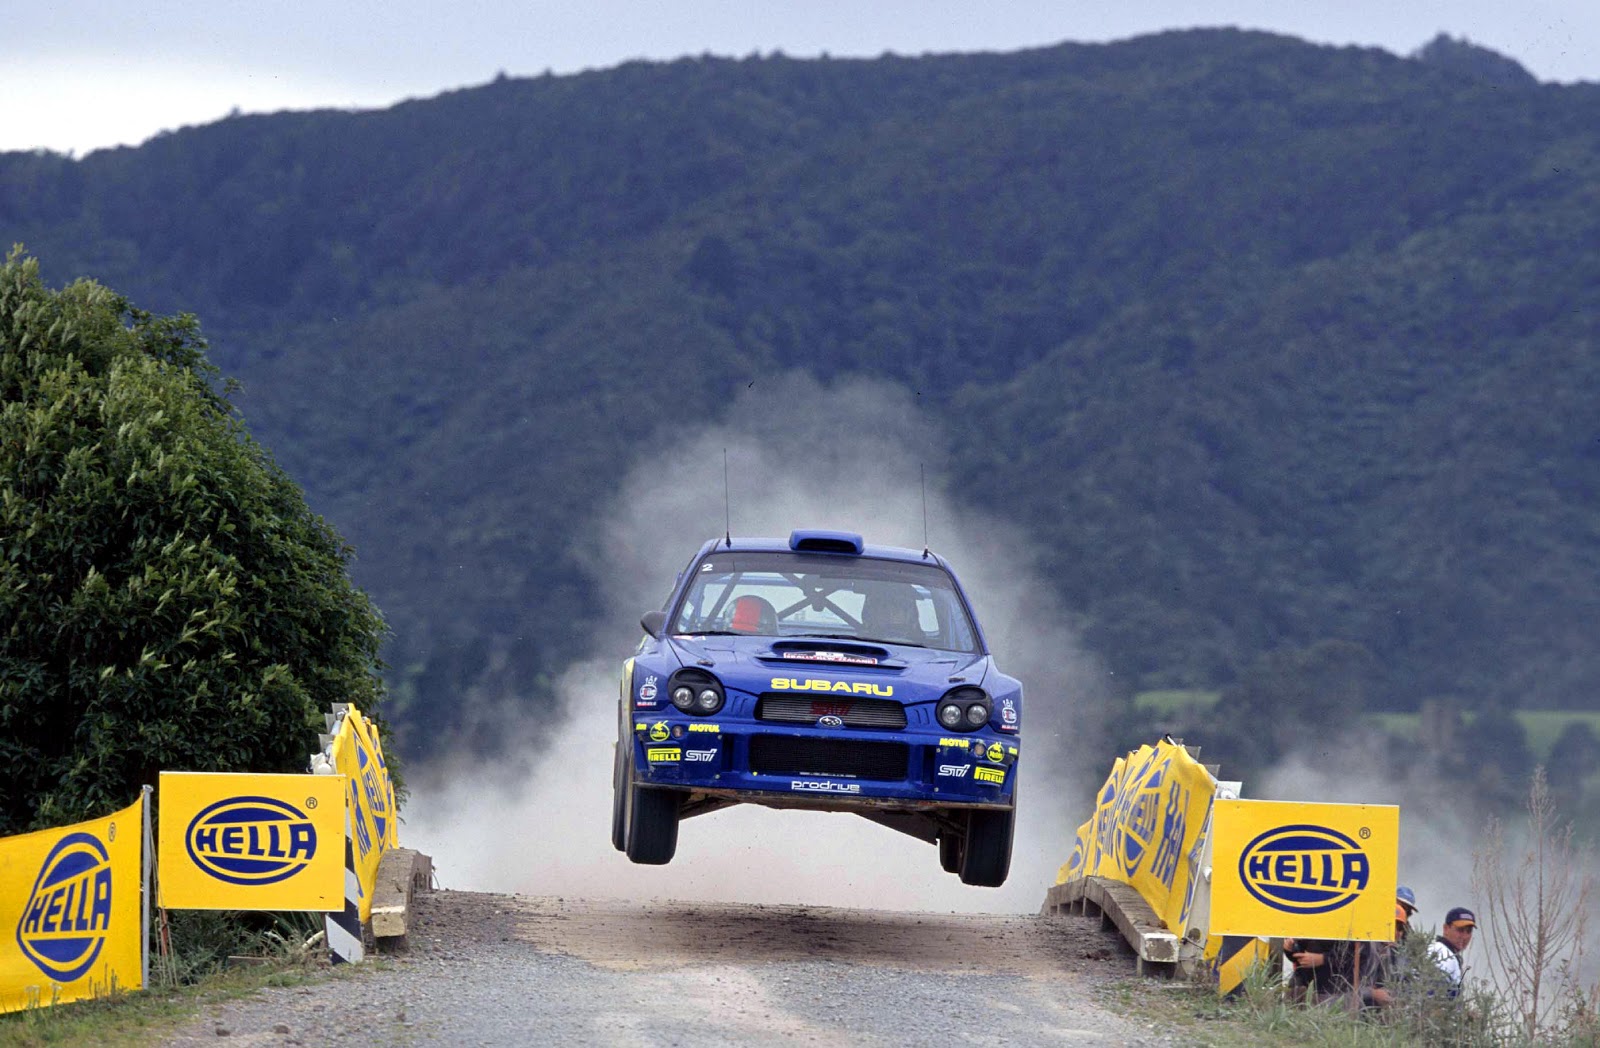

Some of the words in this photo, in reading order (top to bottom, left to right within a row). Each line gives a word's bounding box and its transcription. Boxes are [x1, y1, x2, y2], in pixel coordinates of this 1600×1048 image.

[702, 563, 713, 571] 2
[771, 678, 894, 696] SUBARU
[688, 724, 720, 733] MOTUL
[648, 748, 681, 762] PIRELLI
[195, 822, 317, 860] HELLA
[1249, 853, 1370, 890] HELLA
[25, 868, 112, 933] HELLA
